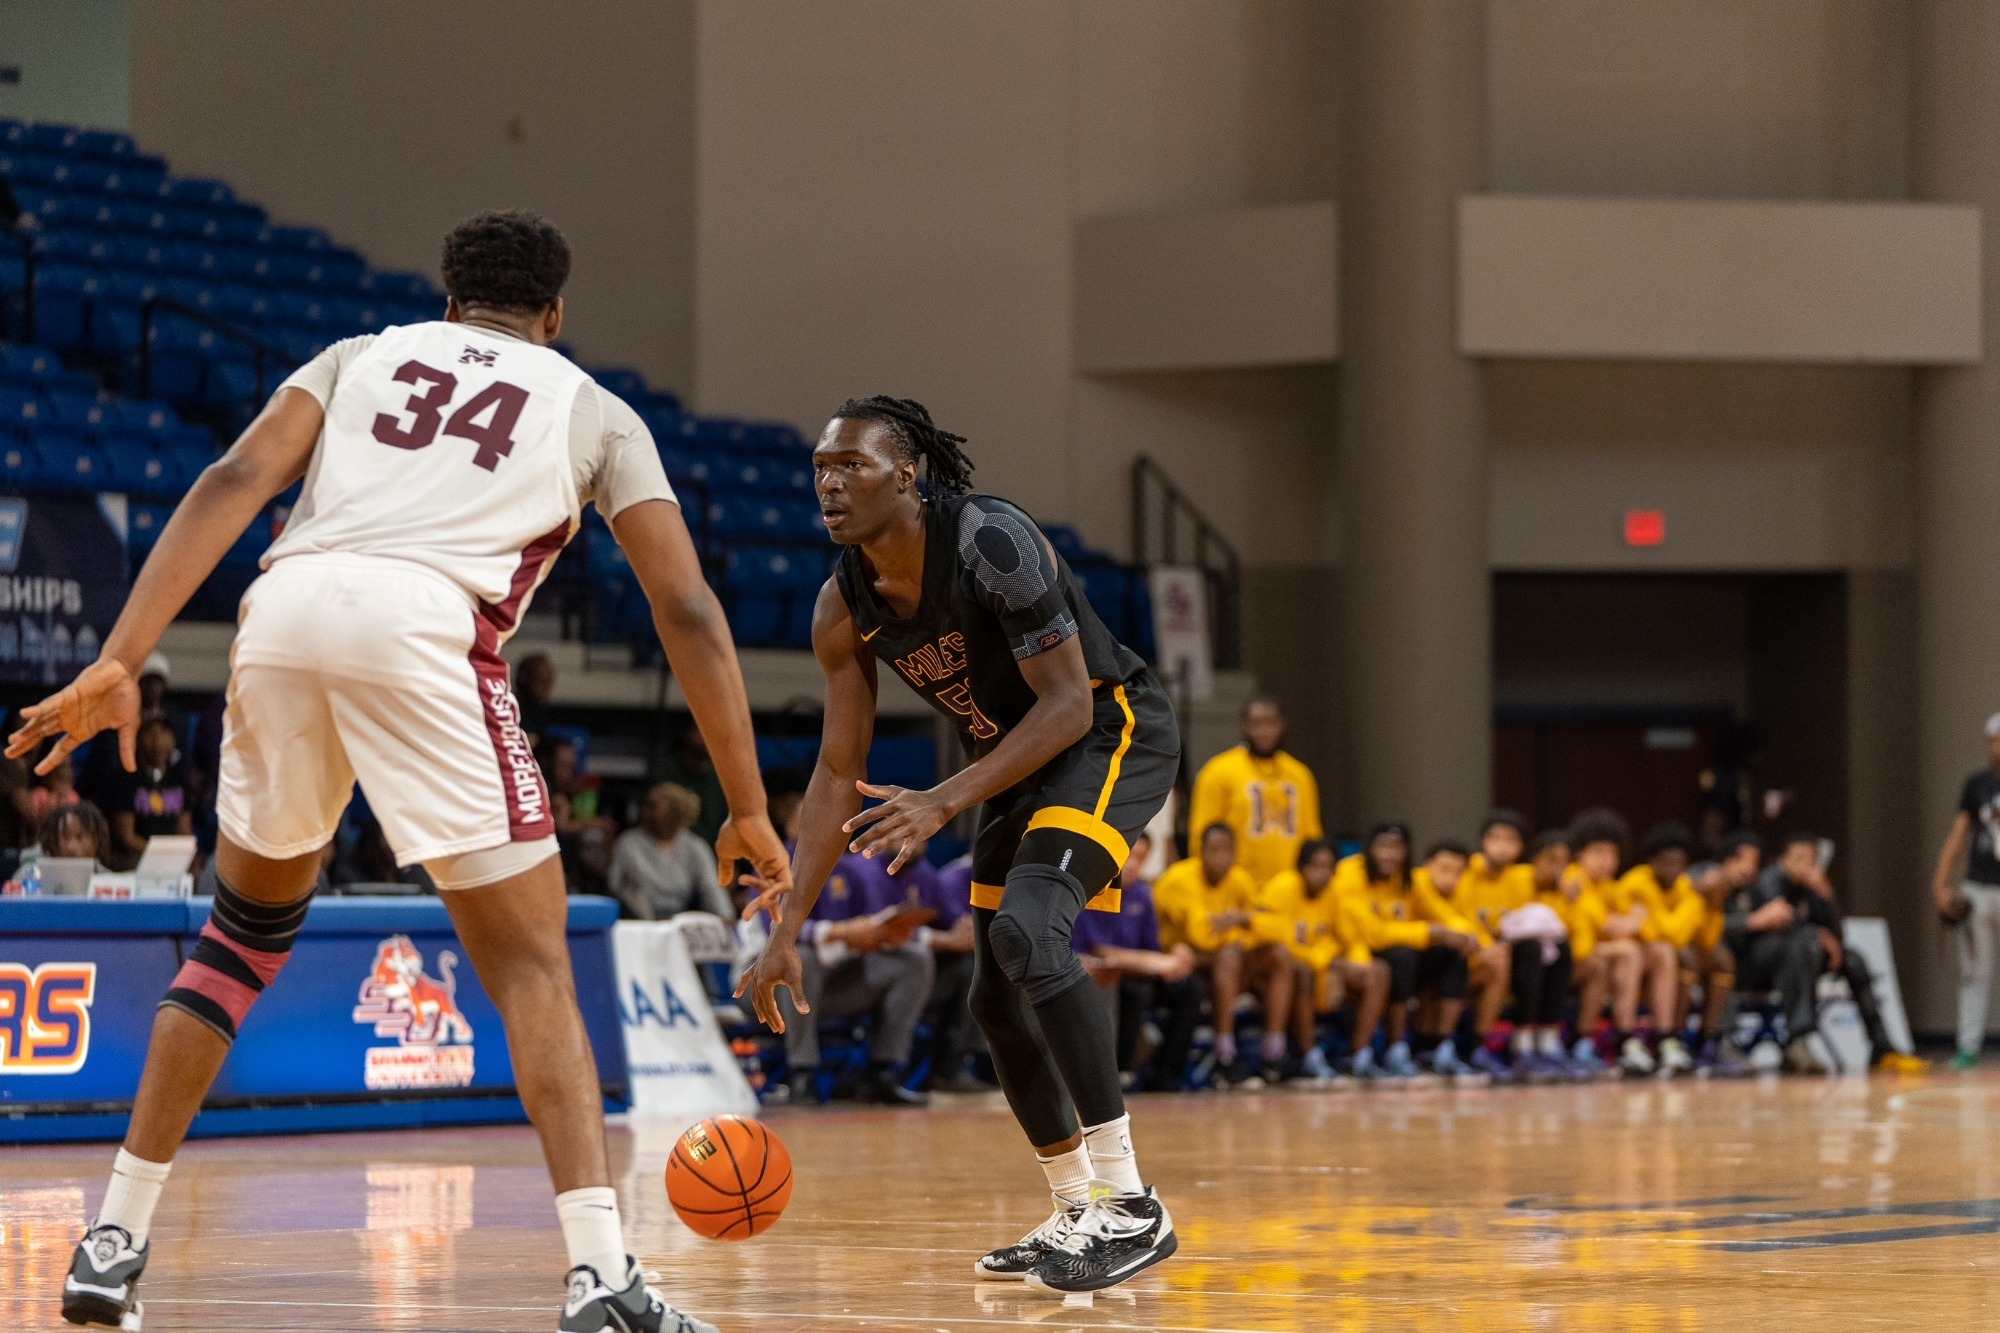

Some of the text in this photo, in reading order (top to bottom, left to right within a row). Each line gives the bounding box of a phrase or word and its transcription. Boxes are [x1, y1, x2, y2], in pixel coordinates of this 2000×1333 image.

[372, 359, 530, 473] 34
[895, 631, 968, 687] MILES
[620, 977, 699, 1028] AA
